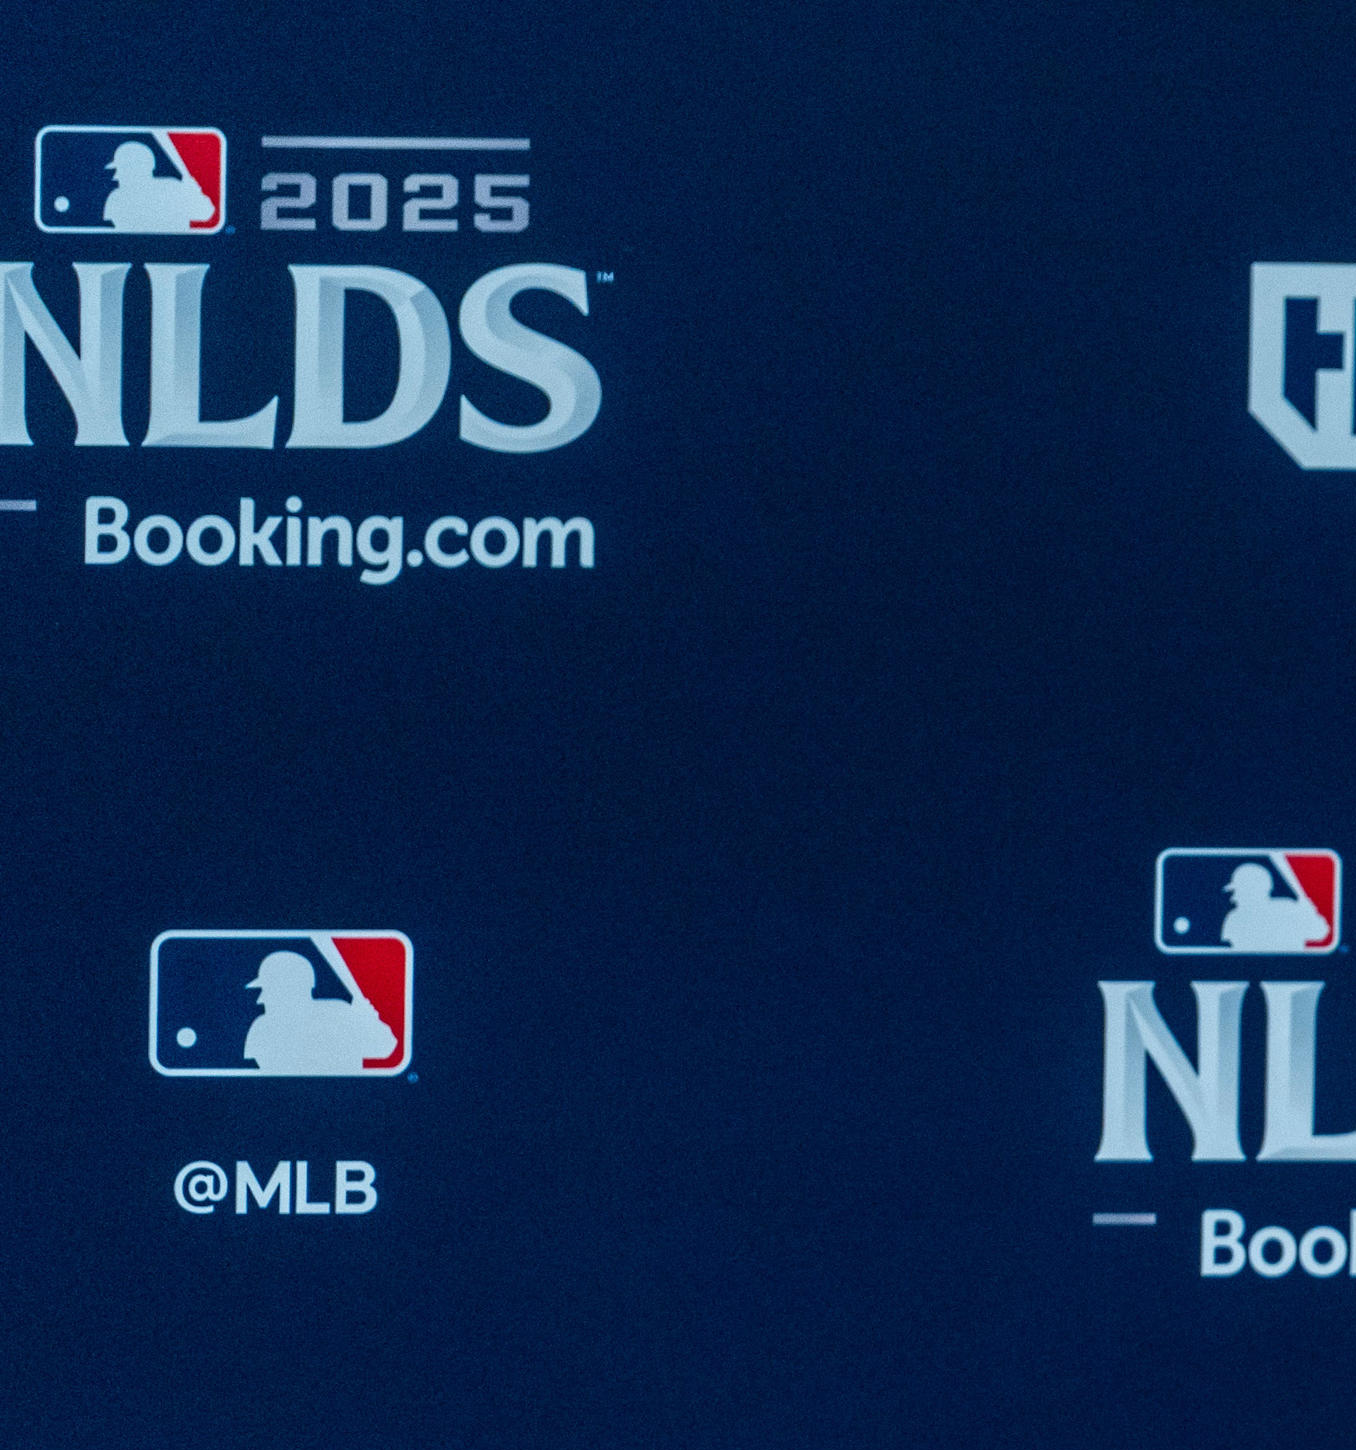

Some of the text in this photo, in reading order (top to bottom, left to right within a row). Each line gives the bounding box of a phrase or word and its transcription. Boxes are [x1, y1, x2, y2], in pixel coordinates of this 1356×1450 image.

[261, 173, 531, 232] 2025
[0, 261, 603, 454] NLDS
[84, 495, 596, 586] Booking.com
[173, 1159, 379, 1215] @MLB
